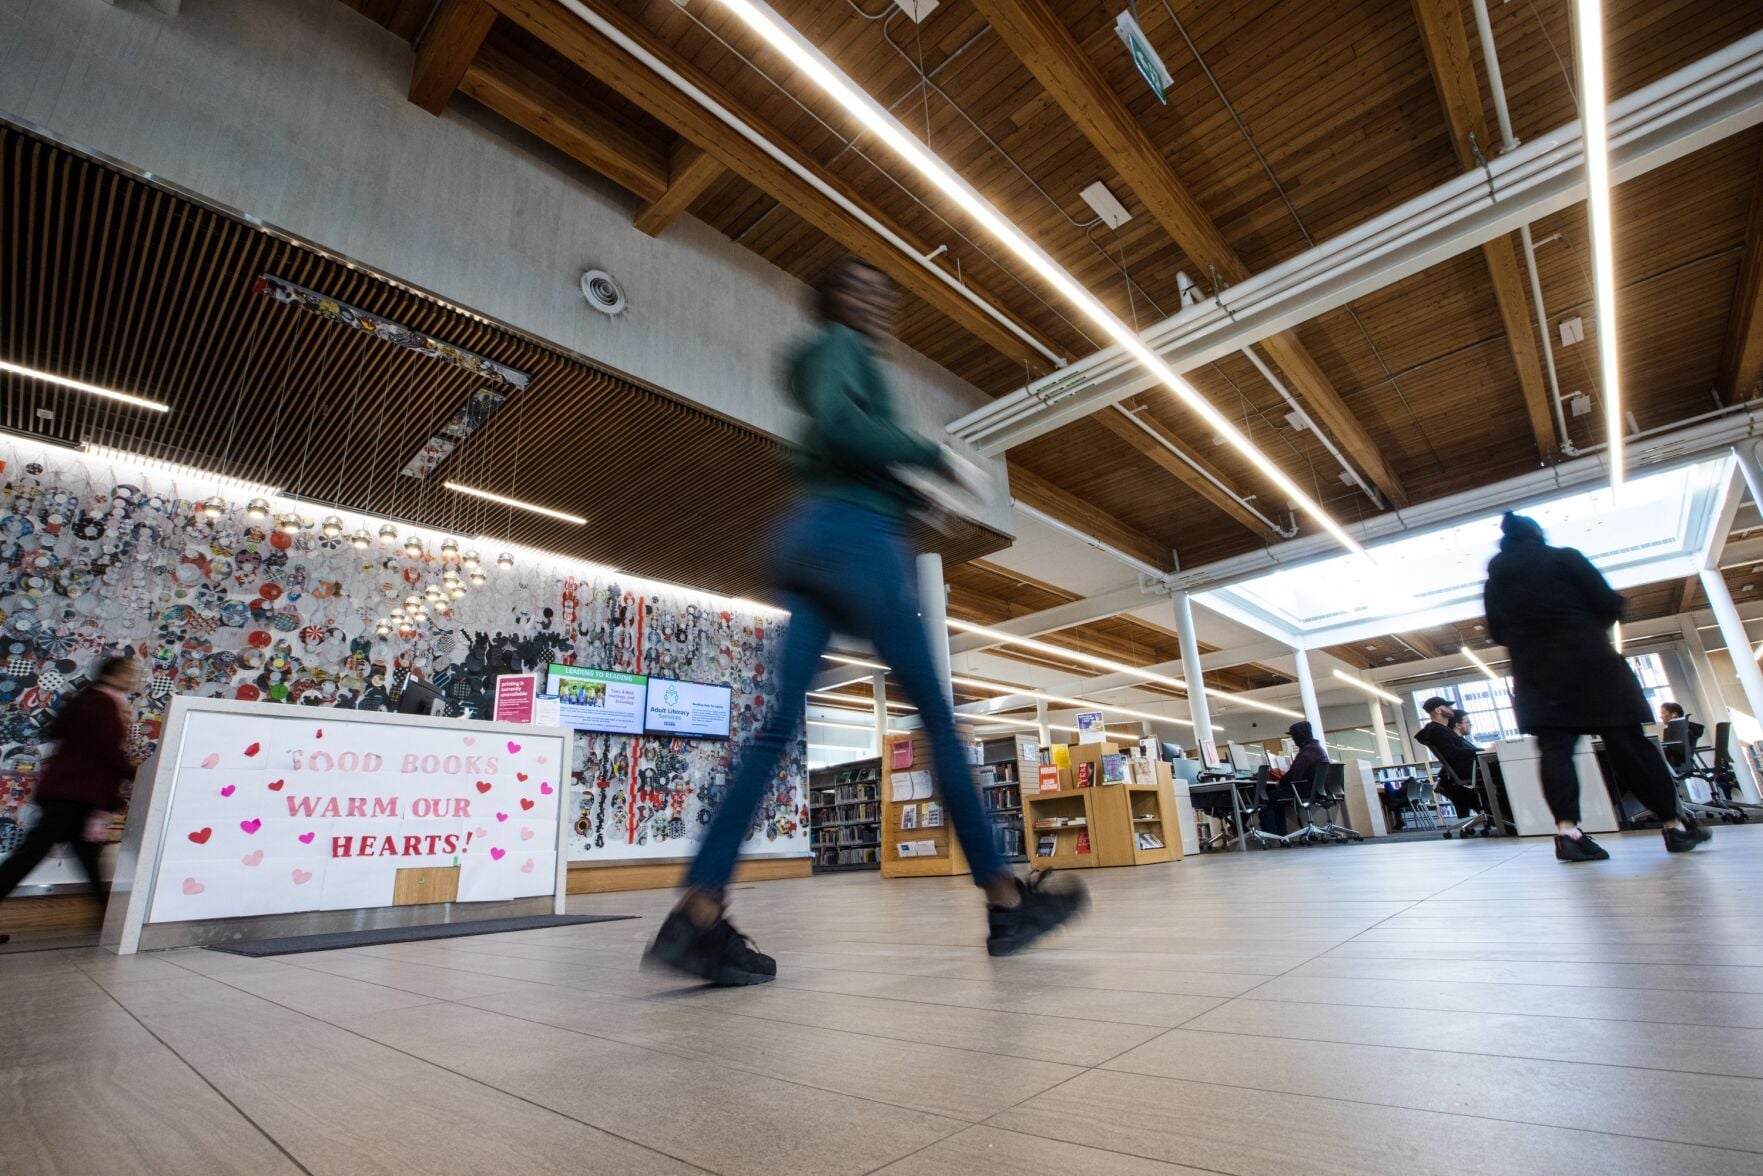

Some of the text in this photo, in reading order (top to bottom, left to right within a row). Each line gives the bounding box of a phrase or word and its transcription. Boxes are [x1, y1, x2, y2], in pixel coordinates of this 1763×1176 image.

[565, 667, 593, 677] LEADING
[605, 672, 633, 682] READING
[400, 753, 499, 775] BOOKS
[286, 795, 471, 818] WARM OUR
[331, 831, 474, 858] HEARTS!
